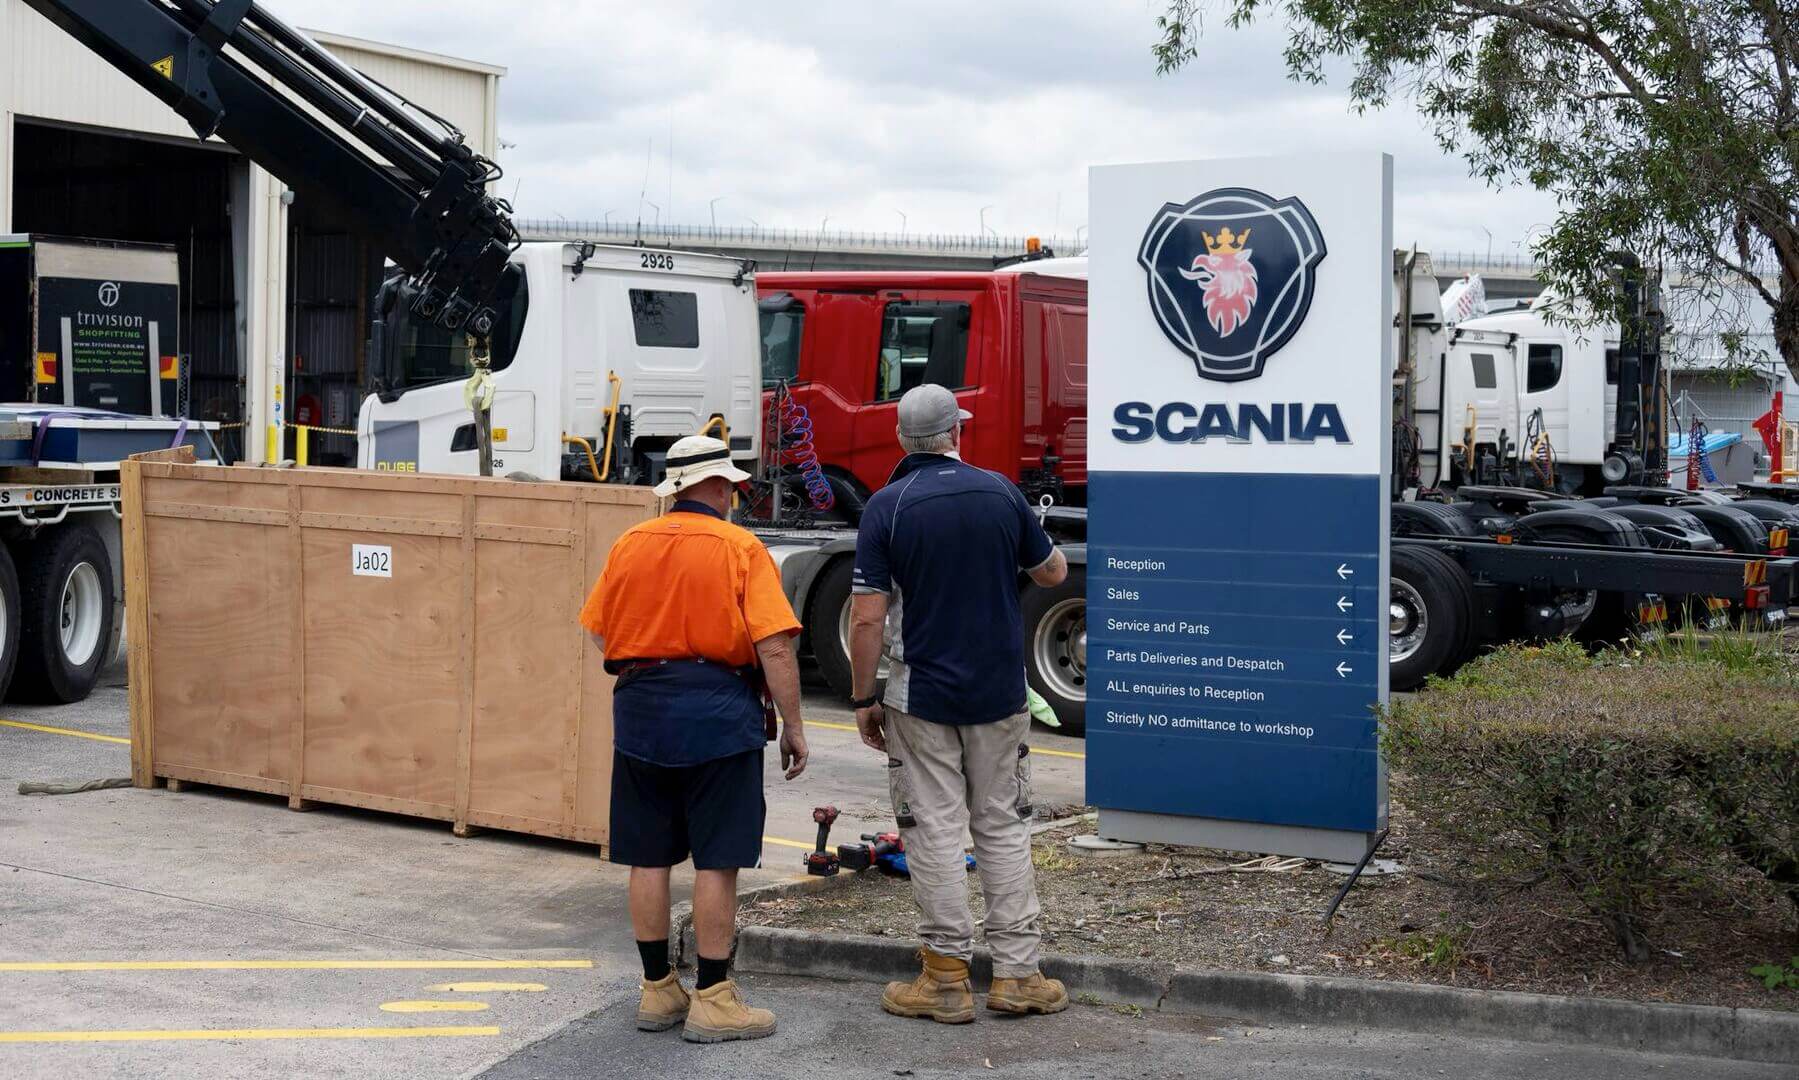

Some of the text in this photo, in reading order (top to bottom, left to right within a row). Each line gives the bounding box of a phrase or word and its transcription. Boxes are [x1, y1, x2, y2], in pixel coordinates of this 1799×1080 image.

[641, 253, 674, 270] 2926
[77, 311, 142, 327] trivision
[79, 329, 140, 338] SHOPFITTING
[1111, 401, 1353, 445] SCANIA
[34, 487, 105, 501] CONCRETE
[356, 551, 388, 571] Ja02
[1107, 557, 1165, 572] Reception
[1107, 587, 1140, 600] Sales
[1107, 618, 1210, 635] Service and Parts
[1107, 650, 1285, 671] Parts Deliveries and Despatch
[1106, 680, 1265, 702] ALL enquiries to Reception
[1106, 711, 1314, 738] Strictly NO admittance to workshop
